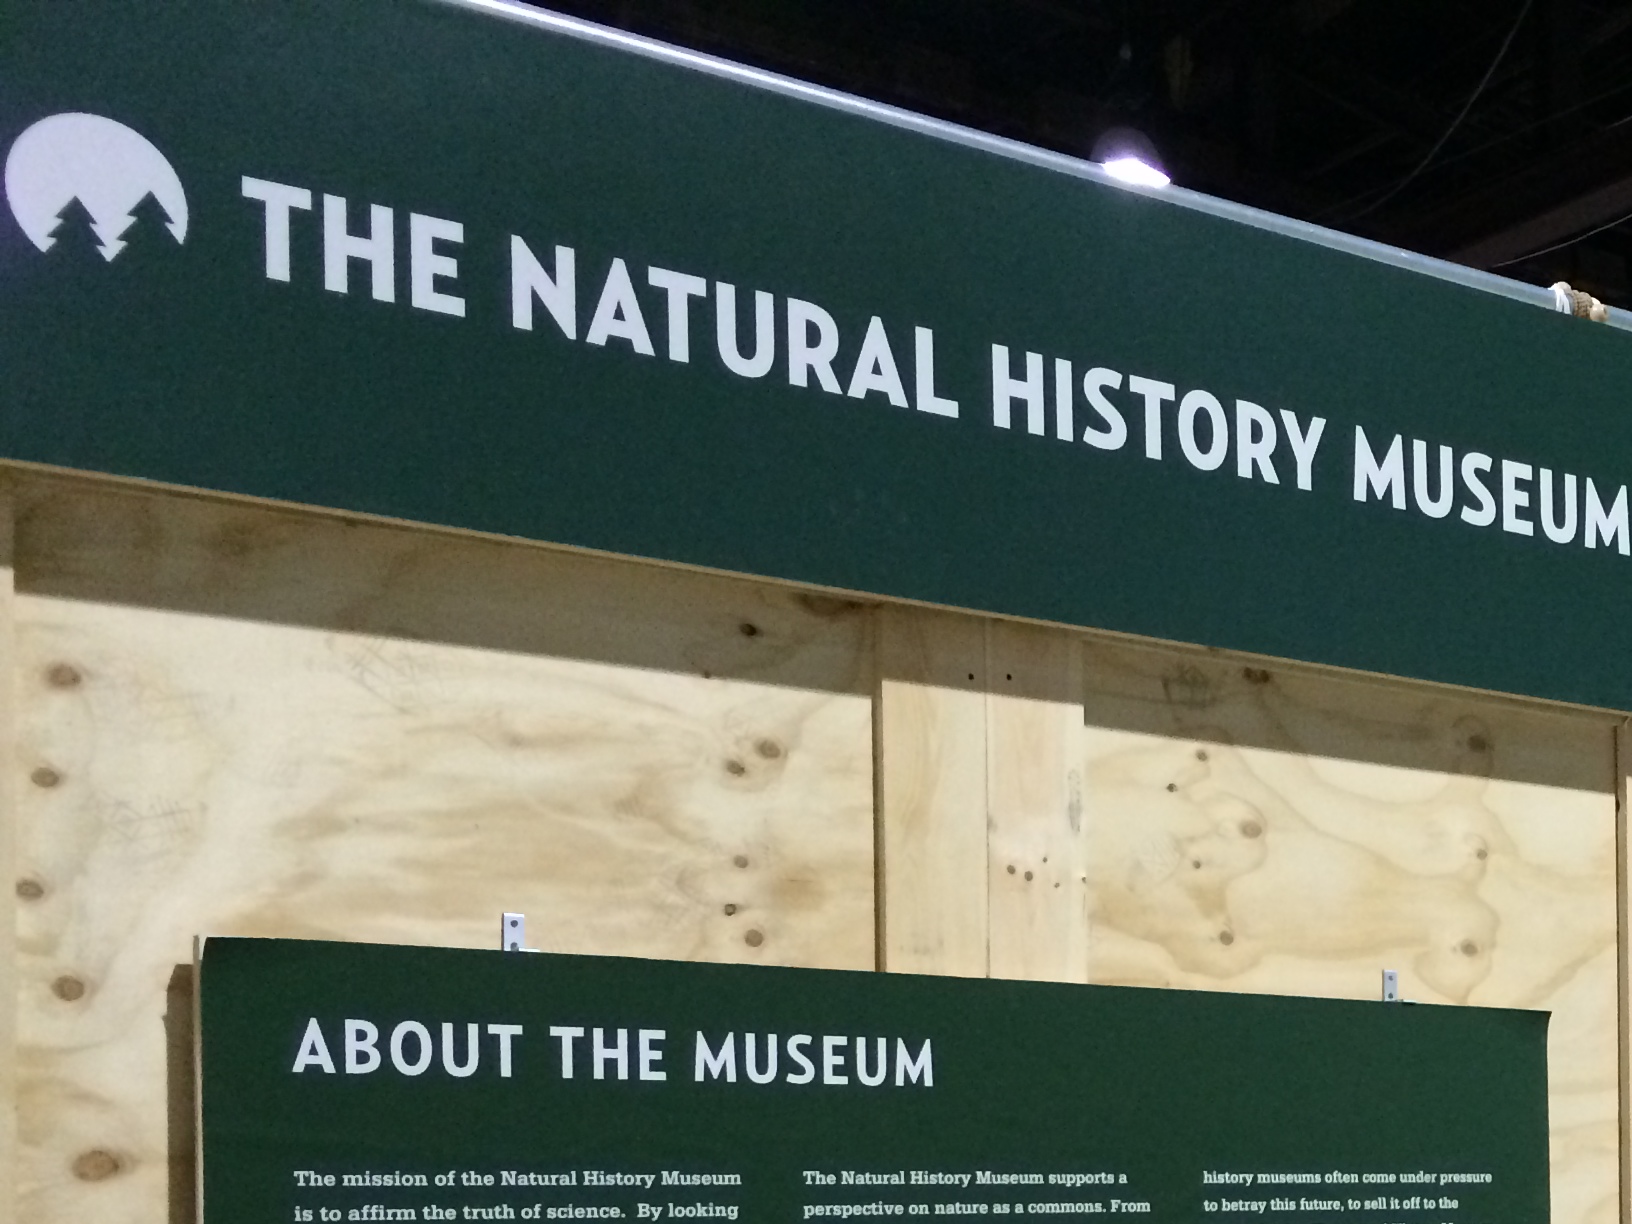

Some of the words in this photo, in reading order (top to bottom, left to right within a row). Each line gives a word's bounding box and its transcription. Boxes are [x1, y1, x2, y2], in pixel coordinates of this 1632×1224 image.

[242, 176, 465, 317] THE
[511, 235, 959, 418] NATURAL
[992, 344, 1326, 491] HISTORY
[1354, 425, 1630, 556] MUSEUM
[292, 1018, 522, 1077] ABOUT
[550, 1026, 666, 1080] THE
[695, 1031, 933, 1086] MUSEUM
[293, 1170, 336, 1186] The
[342, 1170, 428, 1186] mission
[434, 1170, 456, 1186] of
[460, 1170, 494, 1186] the
[500, 1170, 577, 1186] Natural
[582, 1170, 656, 1189] History
[660, 1170, 742, 1185] Museum
[802, 1170, 836, 1185] The
[840, 1170, 905, 1185] Natural
[909, 1170, 972, 1188] History
[975, 1170, 1044, 1184] Museum
[1048, 1171, 1114, 1187] supports
[1118, 1173, 1128, 1184] a
[1202, 1170, 1254, 1186] history
[1256, 1173, 1322, 1184] museums
[1324, 1170, 1359, 1183] often
[1362, 1173, 1396, 1183] come
[1399, 1170, 1437, 1183] under
[1439, 1173, 1492, 1186] pressure
[294, 1205, 313, 1222] is
[319, 1206, 342, 1221] to
[347, 1204, 416, 1221] affirm
[422, 1204, 456, 1220] the
[462, 1203, 515, 1220] truth
[520, 1203, 542, 1219] of
[546, 1203, 626, 1219] science.
[636, 1202, 663, 1221] By
[667, 1202, 739, 1220] looking
[1203, 1199, 1218, 1212] to
[1221, 1198, 1267, 1214] betray
[1269, 1197, 1296, 1211] this
[1299, 1197, 1344, 1212] future,
[1347, 1198, 1361, 1210] to
[1364, 1196, 1387, 1210] sell
[1389, 1196, 1400, 1209] it
[1402, 1196, 1420, 1210] off
[1422, 1198, 1436, 1209] to
[1438, 1196, 1458, 1209] the
